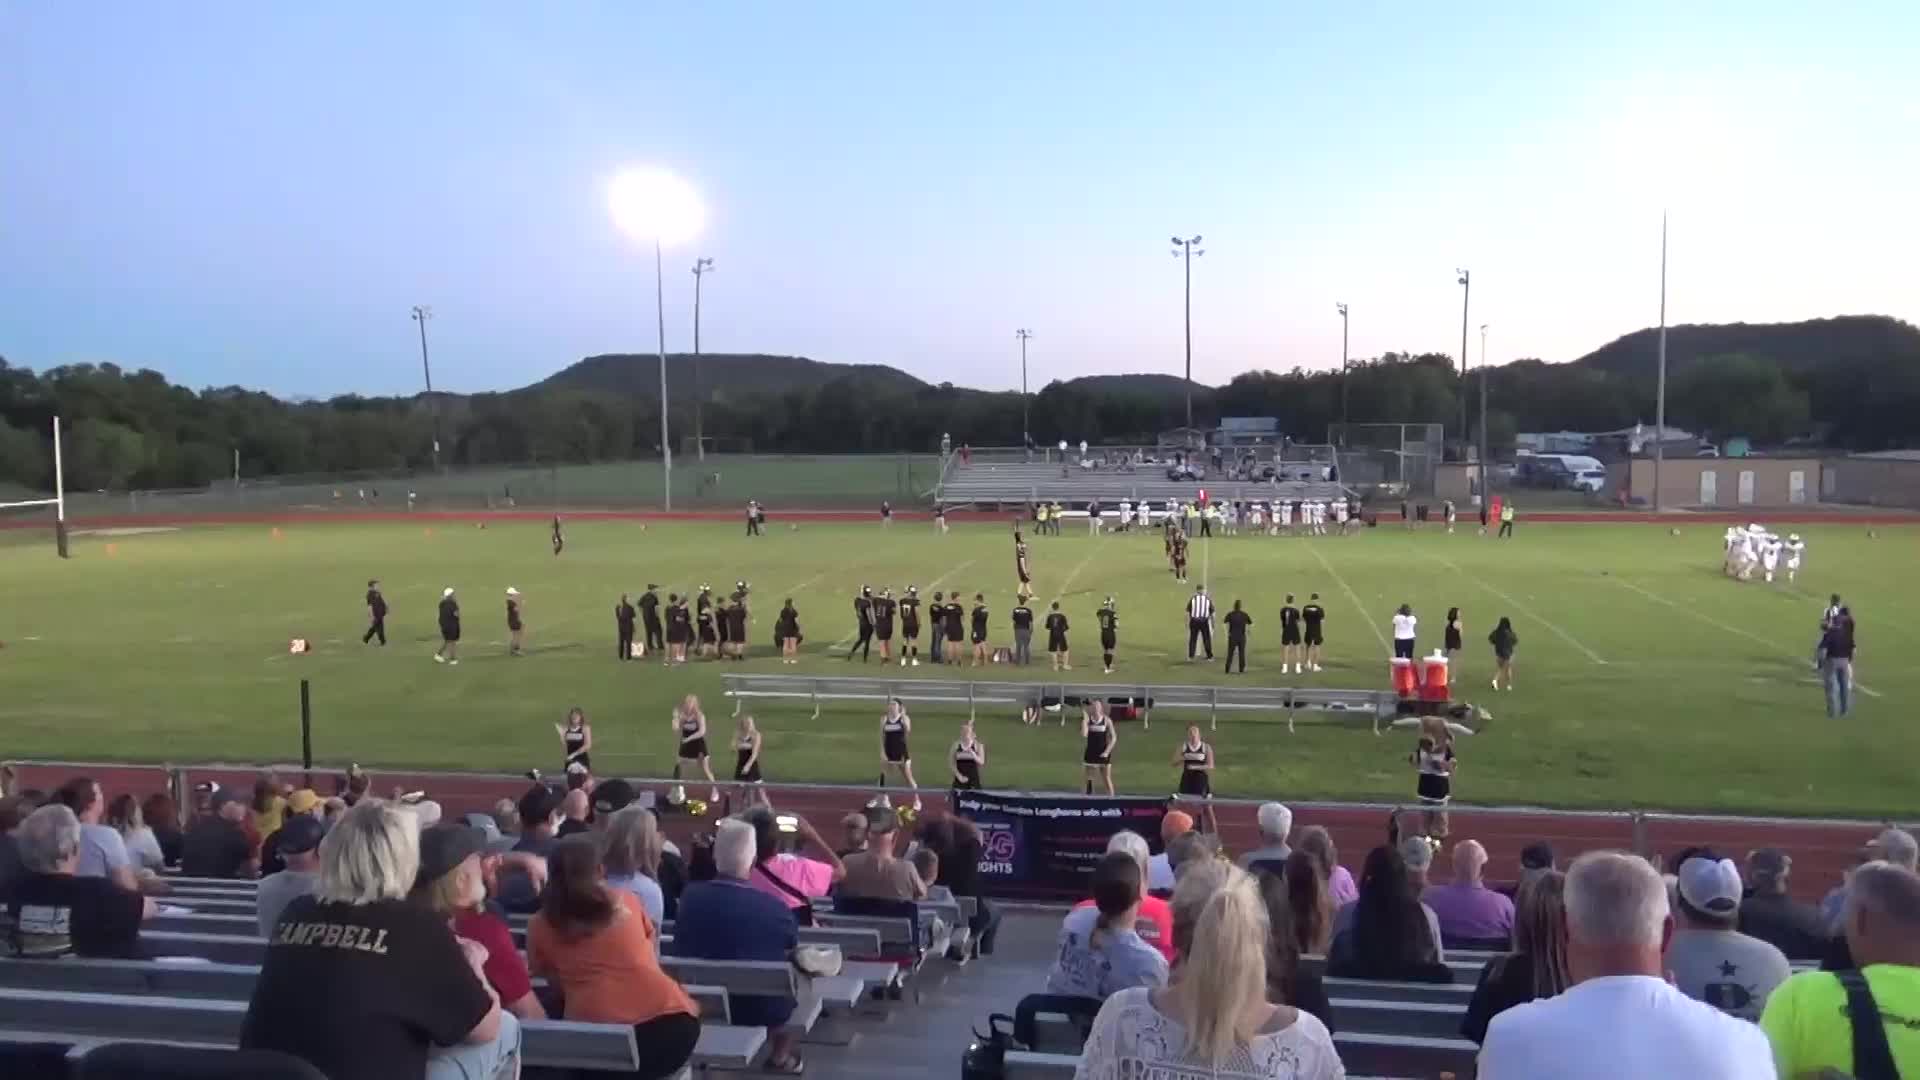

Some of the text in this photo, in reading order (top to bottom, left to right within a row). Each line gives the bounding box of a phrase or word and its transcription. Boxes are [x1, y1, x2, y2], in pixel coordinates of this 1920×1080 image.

[1035, 807, 1082, 819] Longhorns
[1083, 807, 1100, 817] win
[1101, 807, 1122, 817] with
[977, 861, 1013, 874] IGHTS
[279, 922, 389, 953] AMPBELL
